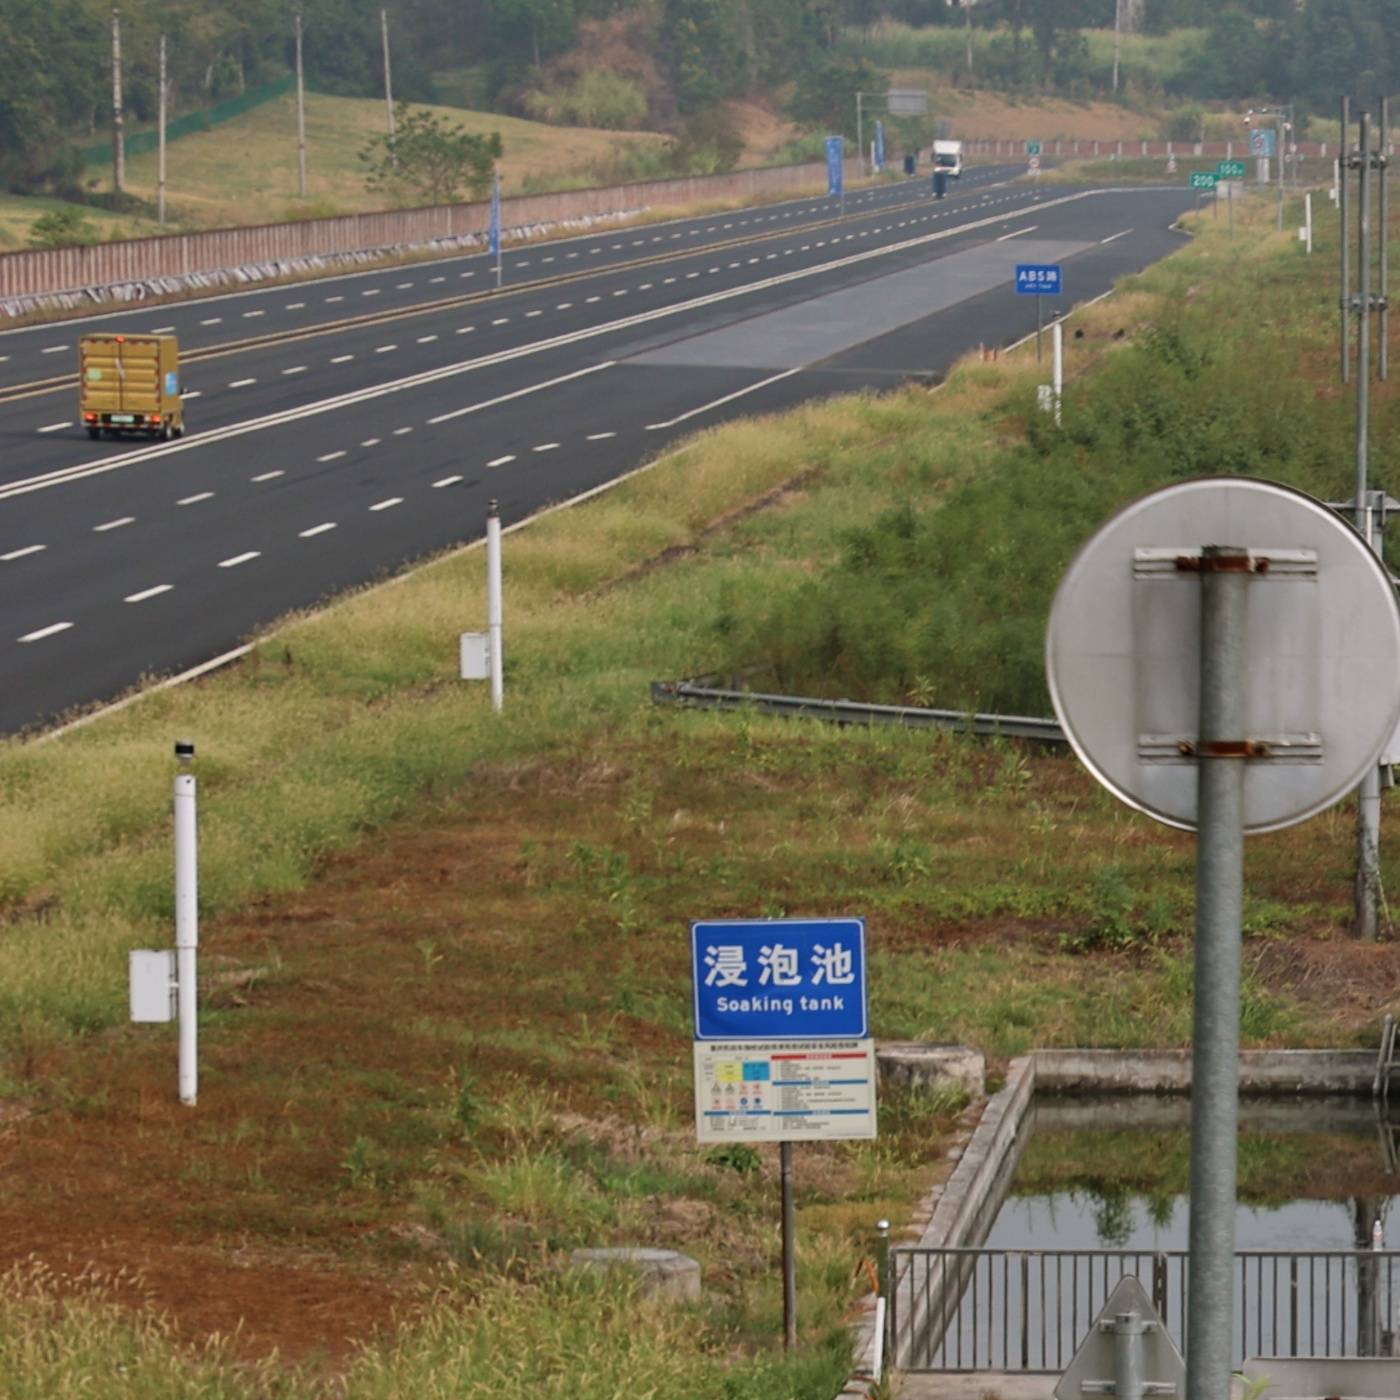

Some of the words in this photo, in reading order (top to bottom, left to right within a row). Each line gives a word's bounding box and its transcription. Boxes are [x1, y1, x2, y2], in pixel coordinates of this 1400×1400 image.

[704, 943, 855, 987] 浸泡池
[717, 996, 793, 1015] Soaking
[800, 996, 844, 1011] tank
